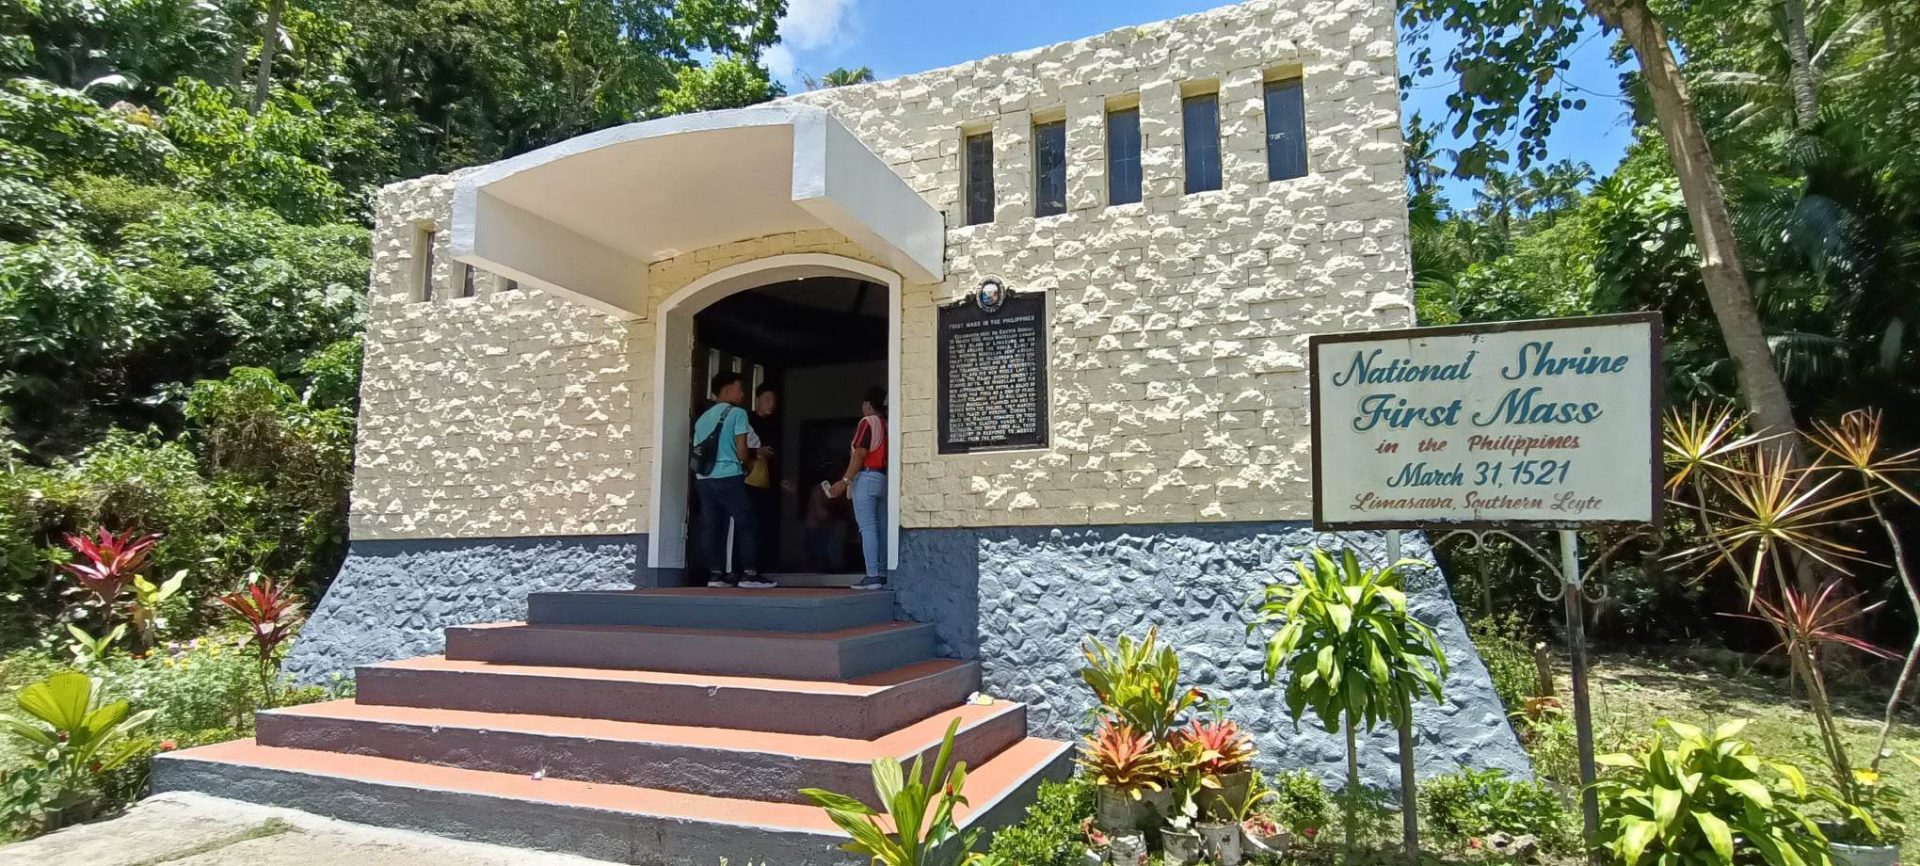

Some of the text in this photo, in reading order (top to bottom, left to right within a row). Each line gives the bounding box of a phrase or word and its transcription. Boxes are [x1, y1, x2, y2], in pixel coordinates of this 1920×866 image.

[1332, 341, 1629, 388] National Shrine
[1353, 386, 1603, 432] First Mass
[1375, 433, 1581, 457] in the Philippines
[1387, 461, 1465, 488] March
[1509, 459, 1572, 486] 1521
[1350, 490, 1602, 515] Limasawa, Southern Leyte
